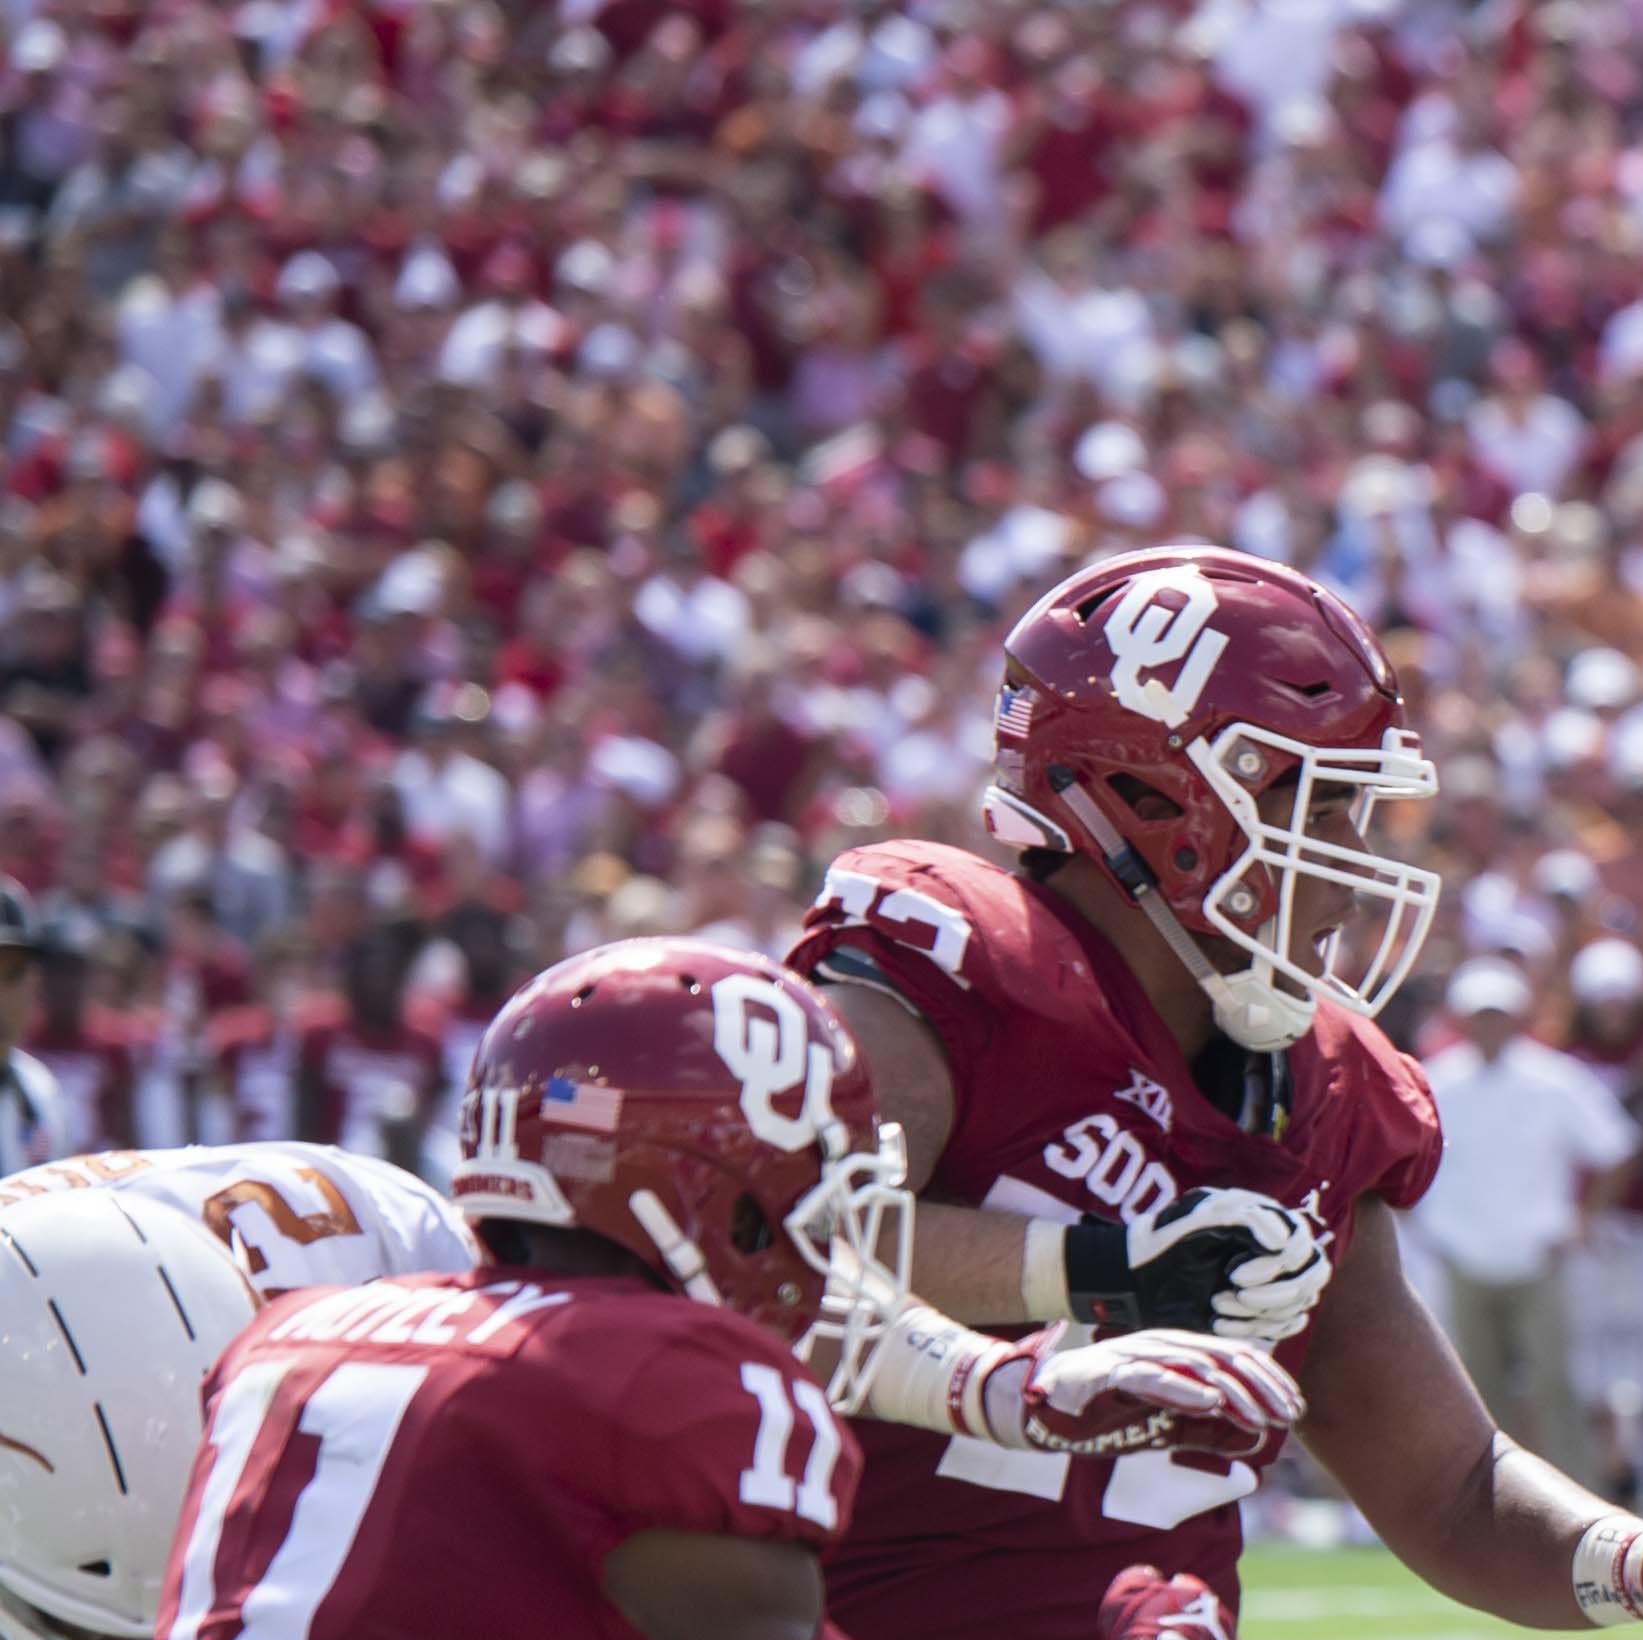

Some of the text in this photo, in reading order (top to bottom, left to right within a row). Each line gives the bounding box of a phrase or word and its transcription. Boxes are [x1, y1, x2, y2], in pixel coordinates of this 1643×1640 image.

[1103, 563, 1231, 730] OU
[711, 973, 834, 1152] OU
[739, 1362, 838, 1530] 11
